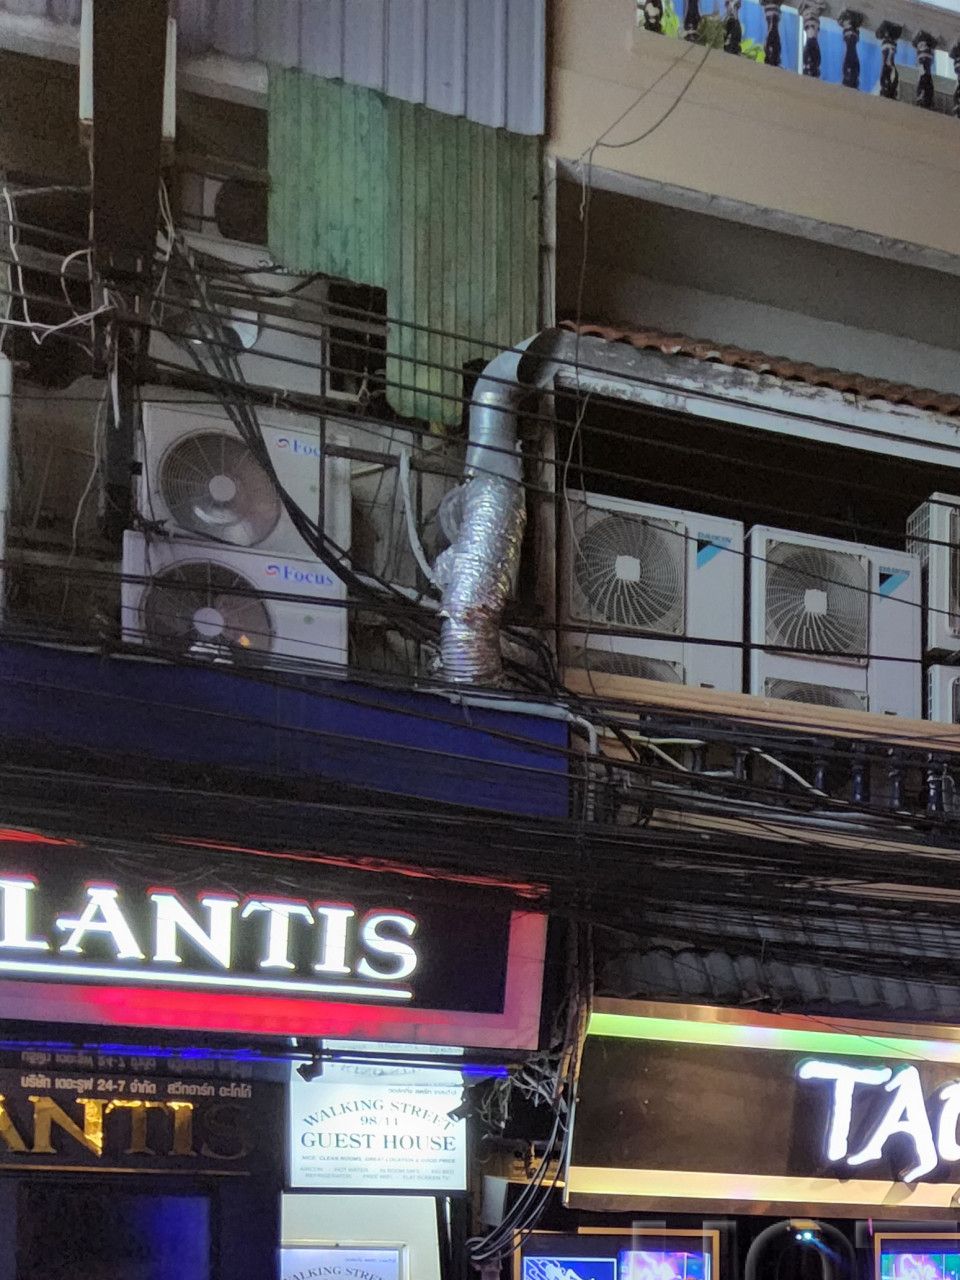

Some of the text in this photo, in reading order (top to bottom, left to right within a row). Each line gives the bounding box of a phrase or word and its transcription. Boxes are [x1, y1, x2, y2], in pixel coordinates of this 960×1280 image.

[293, 439, 321, 457] Foc
[284, 565, 334, 585] Focus
[97, 1078, 125, 1092] 24-7
[303, 1099, 455, 1131] WALKING STREET
[301, 1131, 457, 1151] GUEST HOUSE
